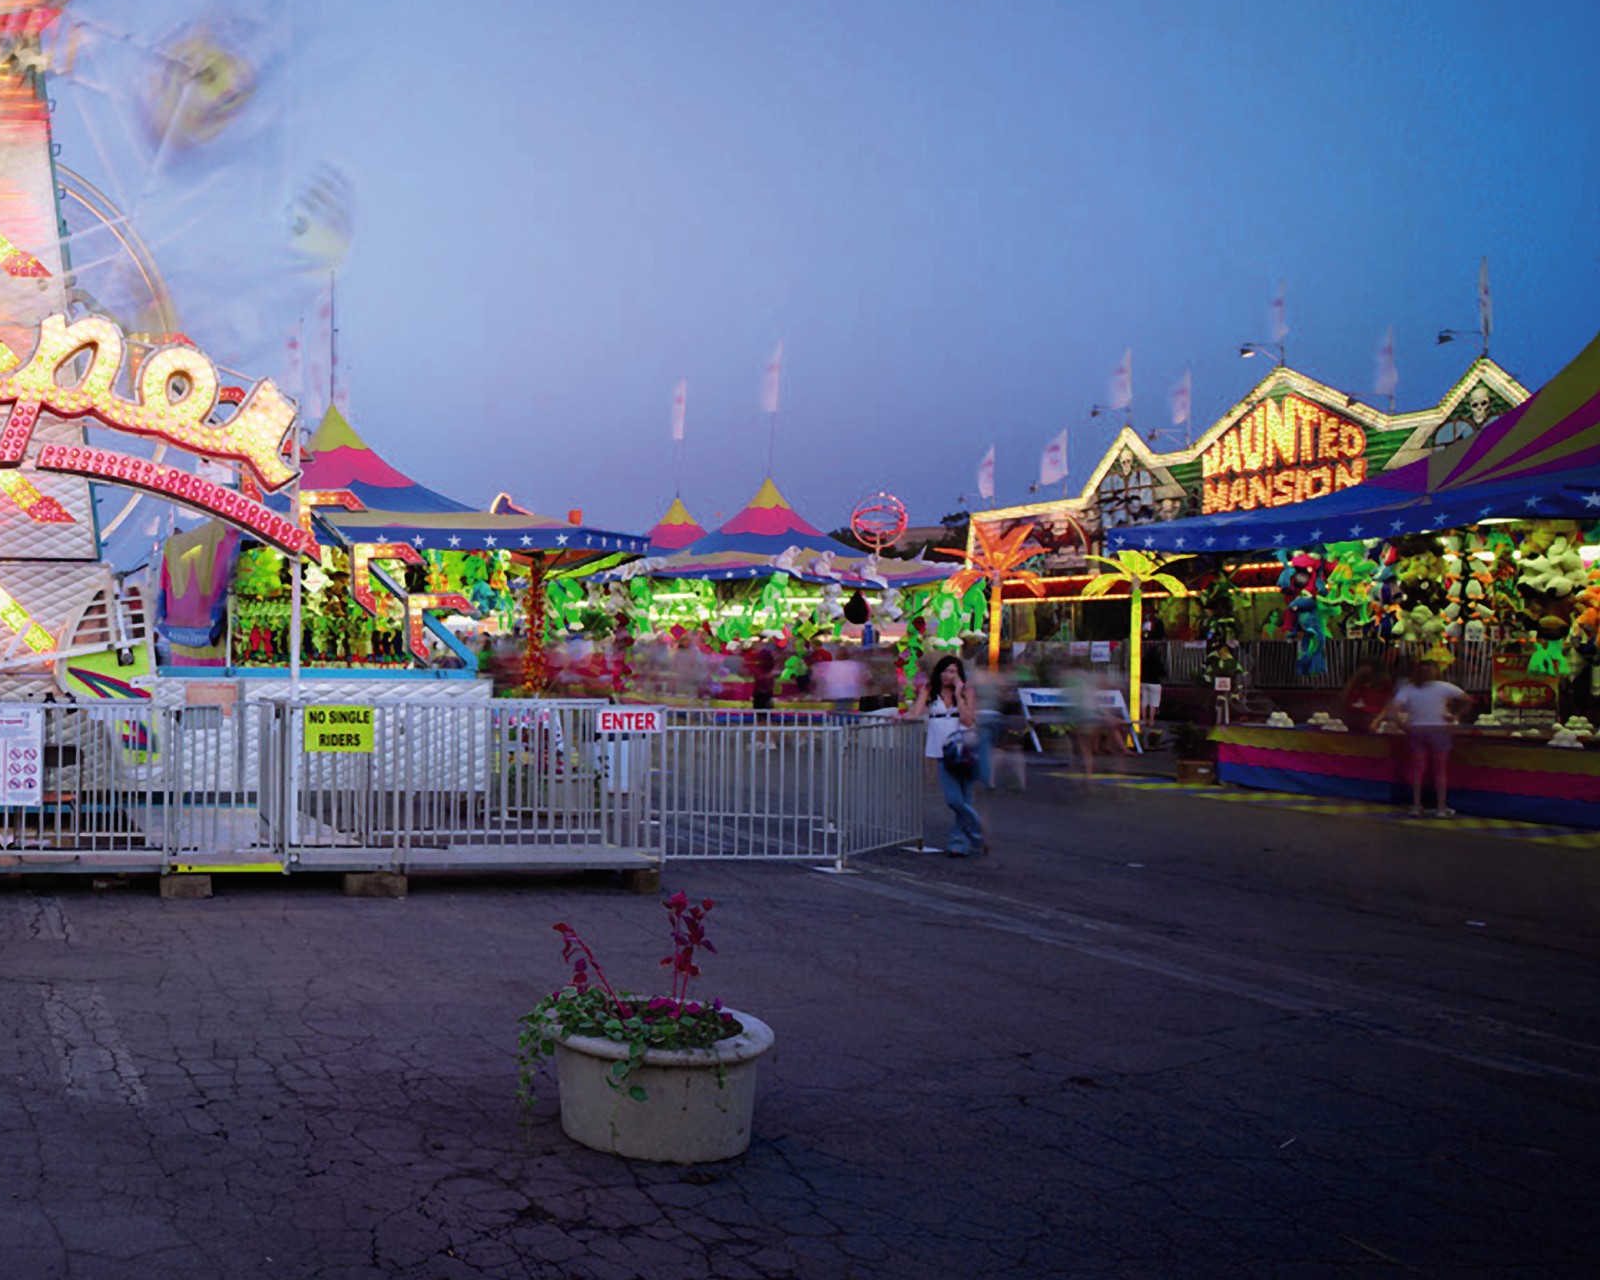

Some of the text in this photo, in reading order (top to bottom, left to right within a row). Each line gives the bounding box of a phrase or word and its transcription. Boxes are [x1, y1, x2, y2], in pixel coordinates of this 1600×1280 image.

[1202, 392, 1367, 478] HAUNTED
[1202, 457, 1367, 515] MANSION
[308, 710, 370, 724] NO SINGLE
[602, 712, 656, 730] ENTER
[318, 733, 361, 747] RIDERS
